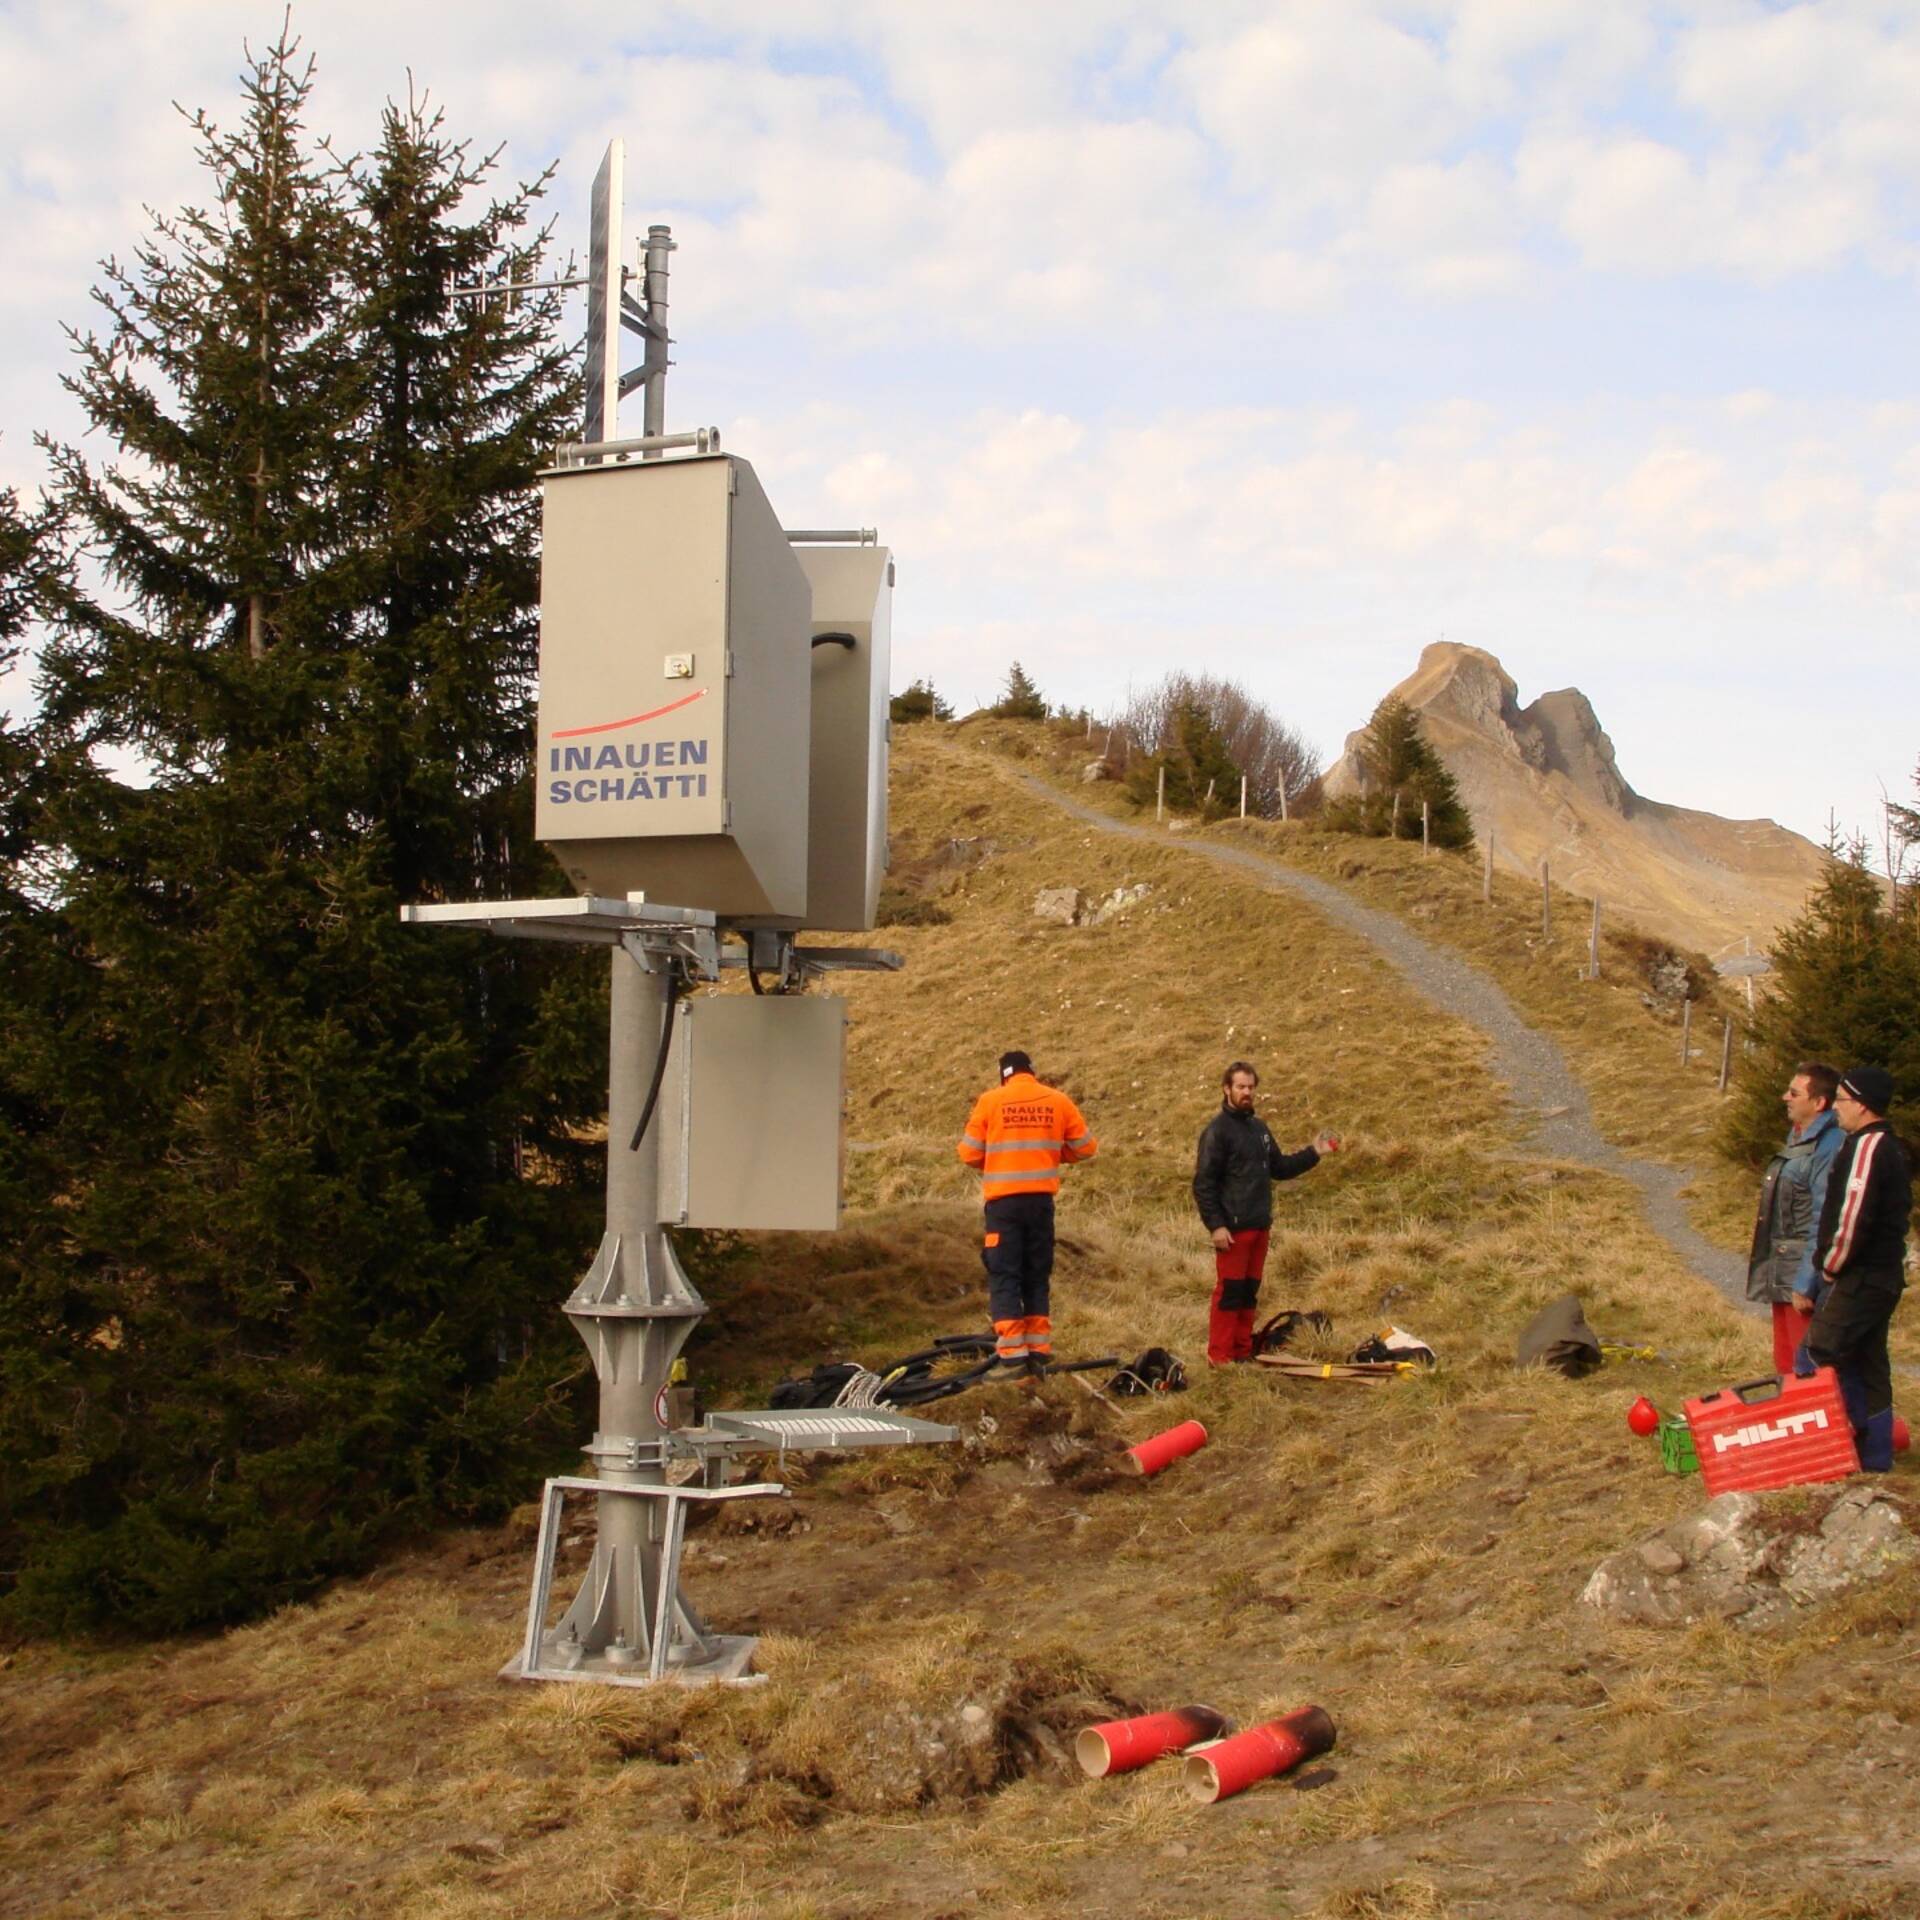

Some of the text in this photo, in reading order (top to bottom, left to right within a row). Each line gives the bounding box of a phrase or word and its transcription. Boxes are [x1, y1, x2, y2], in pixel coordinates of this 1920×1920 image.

[550, 740, 708, 772] INAUEN
[550, 771, 707, 804] SCHÄTTI
[1002, 1106, 1054, 1115] INAUEN
[1713, 1409, 1828, 1453] HILTI
